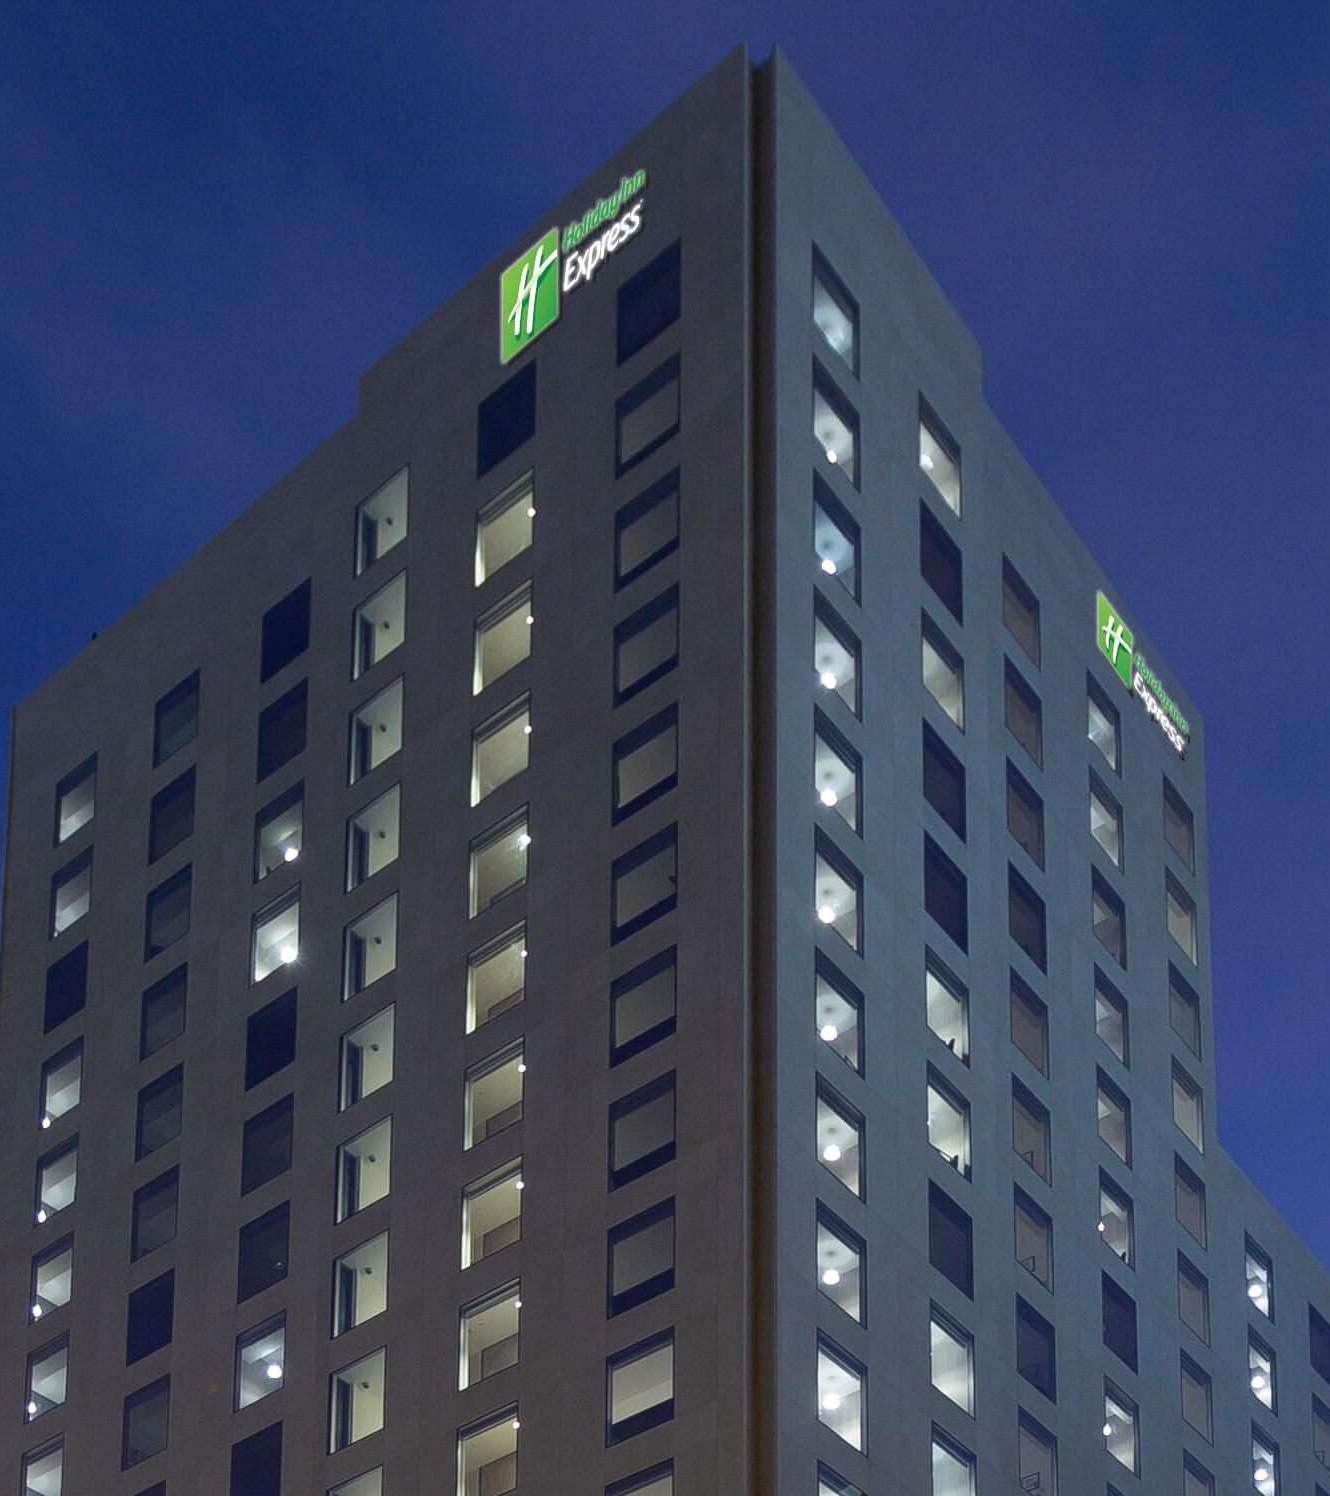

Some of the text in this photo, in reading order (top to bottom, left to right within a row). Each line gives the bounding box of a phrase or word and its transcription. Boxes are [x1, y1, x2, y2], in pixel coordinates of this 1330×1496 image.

[562, 168, 647, 252] Holiday Inn
[563, 203, 642, 293] Express
[1133, 671, 1186, 753] Express
[1134, 652, 1172, 712] Holiday
